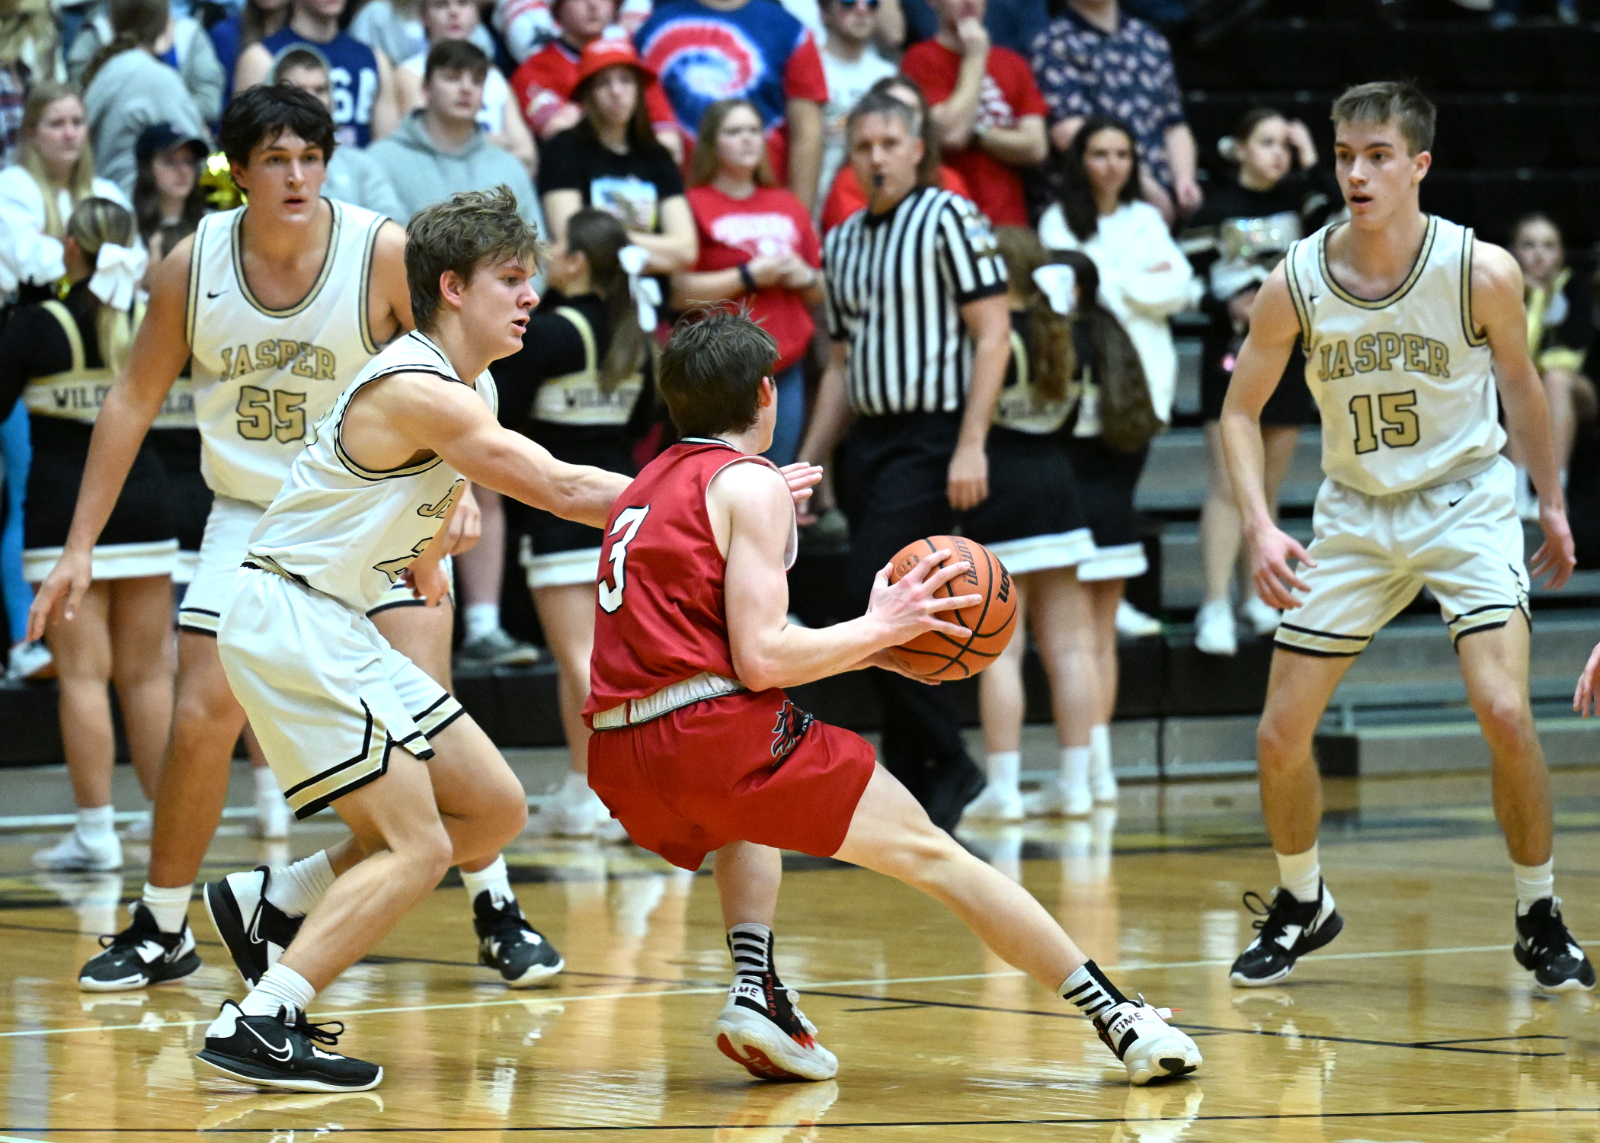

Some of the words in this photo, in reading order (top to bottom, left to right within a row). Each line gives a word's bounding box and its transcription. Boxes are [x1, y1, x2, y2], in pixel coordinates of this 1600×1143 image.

[220, 339, 336, 381] JASPER
[1317, 331, 1450, 382] JASPER
[53, 385, 110, 409] WILD
[236, 385, 307, 444] 55
[1348, 389, 1420, 455] 15
[598, 503, 651, 615] 3
[730, 985, 759, 998] AME
[1112, 1012, 1144, 1035] TIME
